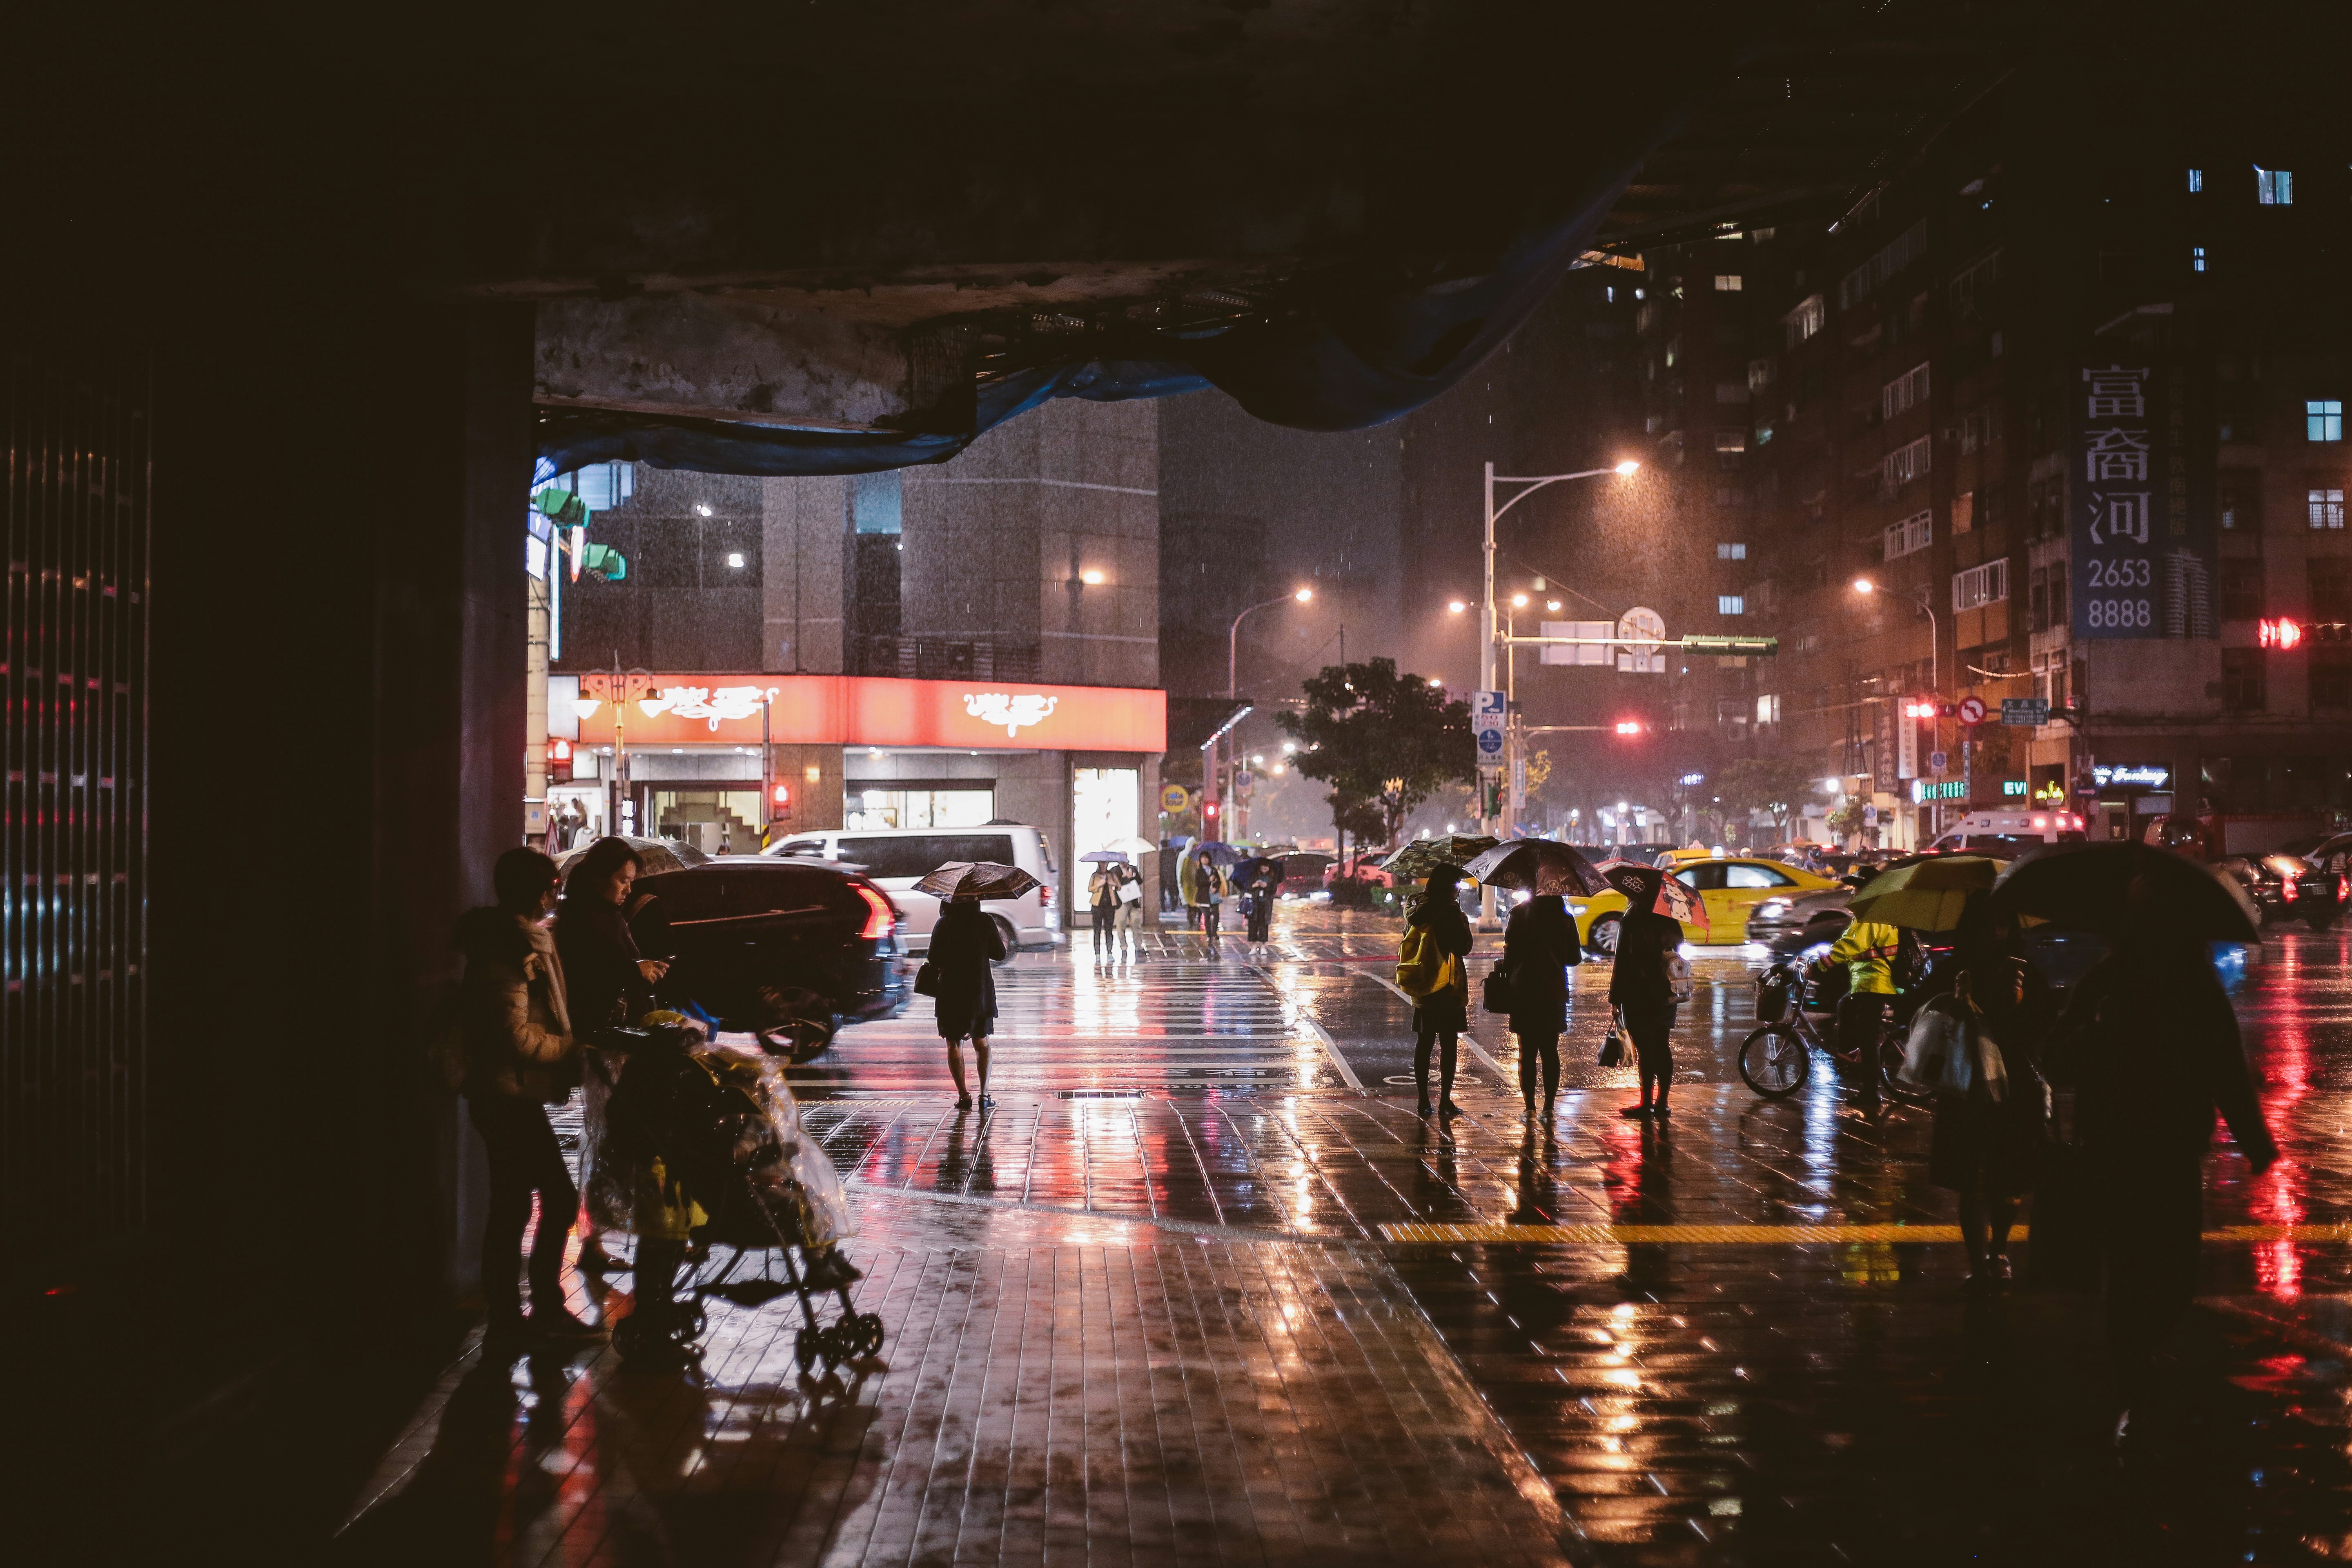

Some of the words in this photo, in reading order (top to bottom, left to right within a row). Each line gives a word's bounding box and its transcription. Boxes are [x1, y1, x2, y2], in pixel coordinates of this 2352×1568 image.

[2082, 363, 2151, 544] 富裔河
[2088, 559, 2151, 588] 2653
[2088, 599, 2151, 628] 8888
[2005, 782, 2027, 795] EV
